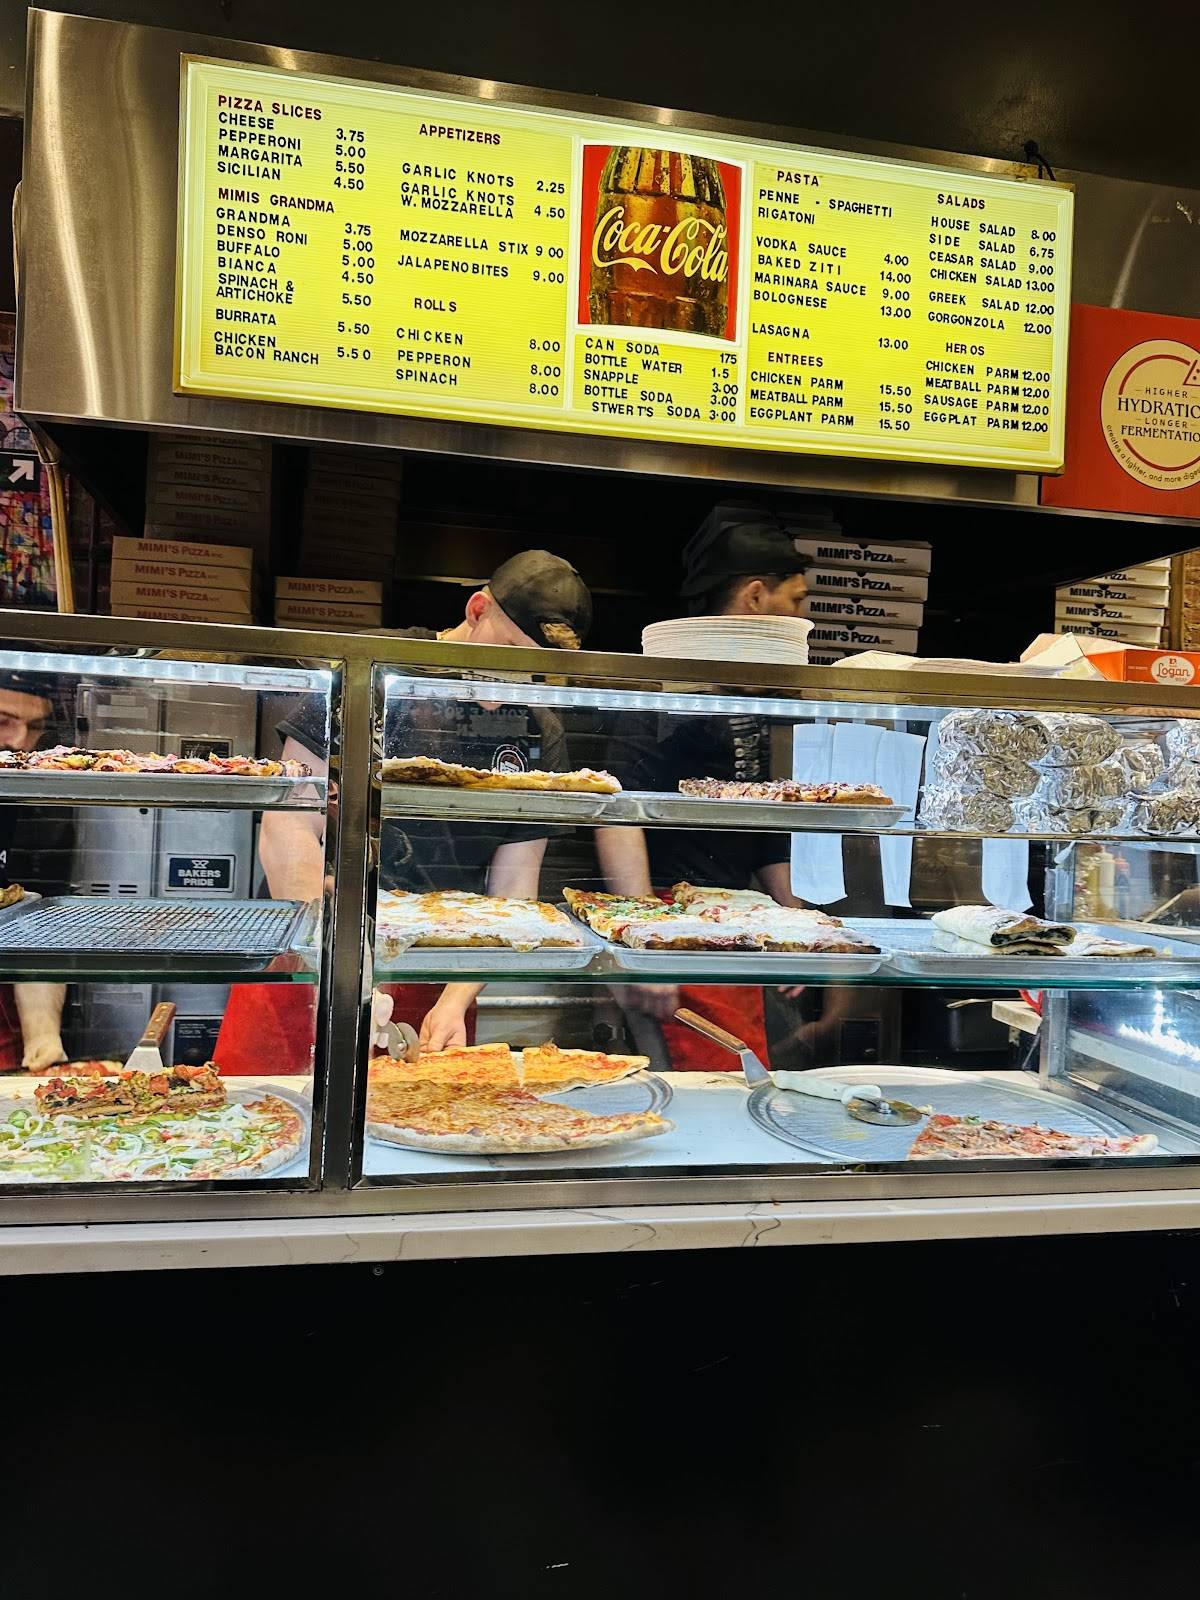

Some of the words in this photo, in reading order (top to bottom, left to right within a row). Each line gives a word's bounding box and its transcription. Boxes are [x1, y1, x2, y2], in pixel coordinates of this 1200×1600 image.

[219, 95, 263, 112] PIZZA
[272, 103, 321, 120] SLICES
[219, 112, 274, 130] CHEESE
[336, 128, 364, 142] 3.75
[420, 124, 500, 145] APPETIZERS
[219, 128, 300, 150] PEPPERONI
[336, 145, 365, 158] 5.00
[219, 145, 302, 166] MARGARITA
[336, 161, 364, 174] 5.50
[218, 162, 280, 180] SICILIAN
[334, 177, 364, 190] 4.50
[403, 163, 456, 179] GARLIC
[468, 171, 513, 187] KNOTS
[537, 181, 564, 194] 2.25
[777, 171, 818, 186] PASTA
[219, 188, 259, 203] MIMIS
[270, 195, 334, 213] GRANDMA
[402, 182, 456, 198] GARLIC
[467, 190, 513, 206] KNOTS
[760, 189, 799, 204] PENNE
[829, 199, 891, 217] SPAGHETTI
[938, 194, 985, 209] SALADS
[217, 208, 290, 226] GRANDMA
[345, 223, 370, 236] 3.75
[535, 206, 564, 218] 4.50
[759, 207, 814, 224] RIGATONI
[217, 224, 265, 239] DENSO
[277, 231, 307, 245] RONI
[344, 239, 372, 252] 5.00
[932, 216, 969, 231] HOUSE
[980, 223, 1015, 236] SALAD
[1031, 230, 1056, 241] 8.00
[218, 240, 279, 257] BUFFALO
[343, 255, 374, 268] 5.00
[401, 230, 488, 250] MOZZARELLA
[499, 242, 527, 255] STIX
[592, 206, 728, 282] Coca-Cola
[757, 236, 796, 251] VODKA
[809, 244, 846, 257] SAUCE
[884, 254, 908, 266] 4.00
[930, 234, 960, 246] SIDE
[979, 241, 1015, 253] SALAD
[1030, 247, 1054, 258] 6.75
[219, 257, 276, 273] BIANCA
[342, 271, 373, 284] 4.50
[759, 255, 800, 269] BAKED
[810, 262, 840, 275] ZITI
[880, 271, 911, 283] 14.00
[930, 251, 973, 266] CEASAR
[981, 258, 1016, 271] SALAD
[1029, 264, 1053, 275] 9.00
[219, 273, 277, 290] SPINACH
[286, 281, 293, 291] &
[533, 271, 564, 283] 9.00
[755, 272, 818, 289] MARINARA
[827, 282, 866, 295] SAUCE
[883, 289, 909, 300] 9.00
[930, 269, 976, 283] CHICKEN
[986, 276, 1021, 288] SALAD
[1026, 281, 1054, 292] 13.00
[216, 286, 292, 304] ARTICHOKE
[343, 293, 371, 306] 5.50
[415, 298, 456, 312] ROLLS
[754, 290, 827, 308] BOLOGNESE
[881, 306, 911, 318] 13.00
[929, 292, 965, 305] GREEK
[983, 298, 1019, 311] SALAD
[1026, 304, 1054, 315] 12.00
[216, 309, 276, 325] BURRATA
[338, 322, 369, 334] 5.50
[928, 312, 1004, 329] GORGONZOLA
[1024, 323, 1051, 334] 12.00
[214, 331, 275, 347] CHICKEN
[397, 328, 462, 344] CHICKEN
[530, 339, 560, 352] 8.00
[586, 338, 613, 350] CAN
[627, 343, 659, 355] SODA
[753, 323, 809, 339] LASAGNA
[879, 338, 908, 350] 13.00
[216, 344, 264, 359] BACON
[274, 350, 318, 364] RANCH
[338, 347, 370, 360] 5.50
[398, 350, 470, 368] PEPPERON
[531, 365, 560, 377] 8.00
[586, 353, 627, 367] BOTTLE
[642, 360, 681, 373] WATER
[712, 368, 729, 378] 1.5
[768, 352, 823, 367] ENTREES
[396, 369, 456, 385] SPINACH
[530, 383, 558, 396] 8.00
[584, 369, 638, 384] SNAPPLE
[713, 383, 738, 394] 3.00
[926, 361, 974, 374] CHICKEN
[987, 367, 1018, 379] PARM
[1023, 371, 1050, 382] 12.00
[751, 371, 801, 385] CHICKEN
[811, 378, 843, 390] PARM
[880, 385, 911, 396] 15.50
[926, 377, 981, 392] MEATBALL
[988, 384, 1019, 396] PARM
[1023, 388, 1049, 398] 12.00
[1145, 387, 1188, 398] HIGHER
[585, 385, 627, 399] BOTTLE
[641, 391, 672, 403] SODA
[711, 395, 736, 407] 3.00
[751, 389, 808, 404] MEATBALL
[812, 395, 842, 407] PARM
[880, 402, 912, 413] 15.50
[925, 395, 977, 408] SAUSAGE
[987, 401, 1018, 412] PARM
[1022, 404, 1049, 415] 12.00
[667, 406, 700, 418] SODA
[751, 408, 812, 422] EGGPLANT
[822, 414, 853, 425] PARM
[880, 419, 910, 430] 15.50
[924, 412, 976, 425] EGGPLAT
[988, 418, 1019, 430] PARM
[1022, 421, 1048, 432] 12.00
[1145, 418, 1188, 429] LONGER
[817, 547, 862, 561] MIMI'S
[816, 575, 860, 589] MIMI'S
[810, 602, 854, 615] MIMI'S
[1156, 663, 1190, 678] Logan
[178, 869, 221, 878] BAKERS
[183, 878, 214, 886] PRIDE
